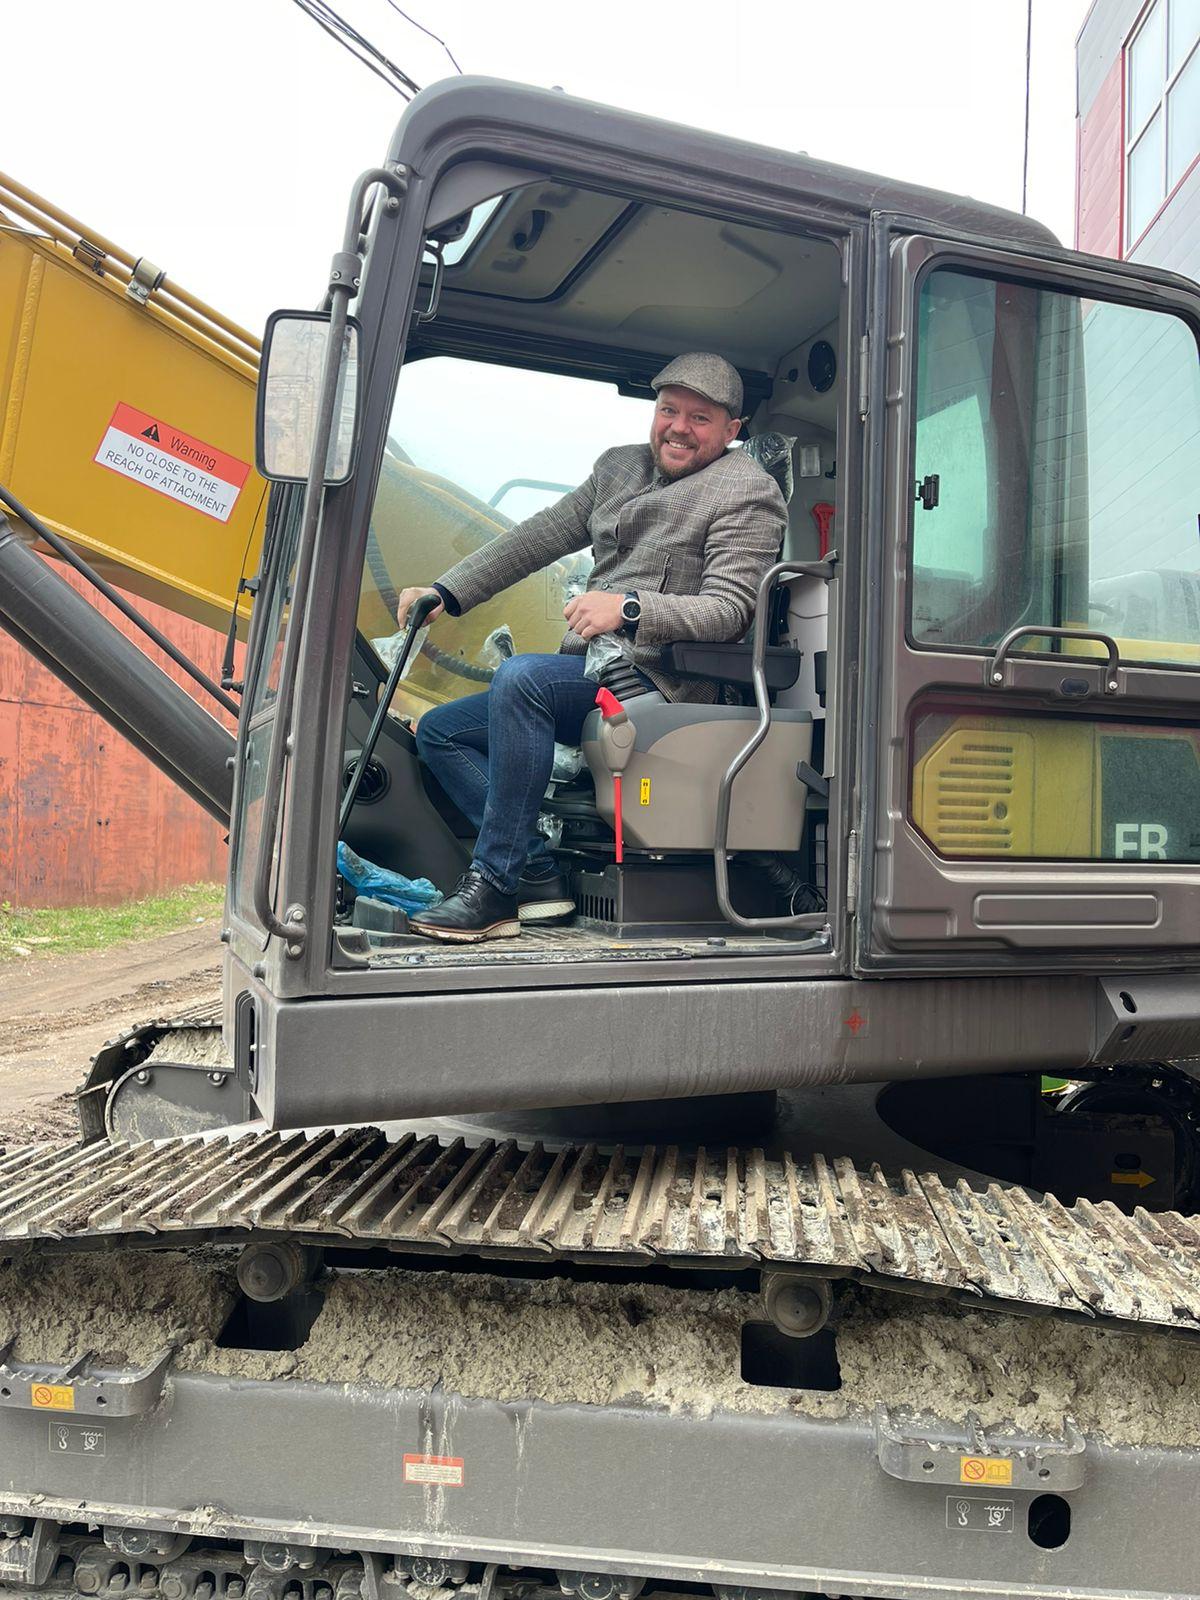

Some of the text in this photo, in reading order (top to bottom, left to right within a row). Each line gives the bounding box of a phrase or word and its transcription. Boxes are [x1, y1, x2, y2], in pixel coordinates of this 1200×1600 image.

[127, 443, 218, 494] NO CLOSE TO THE
[170, 437, 217, 471] Warning
[106, 450, 227, 514] REACH OF ATTACHMENT
[1115, 823, 1168, 860] FR
